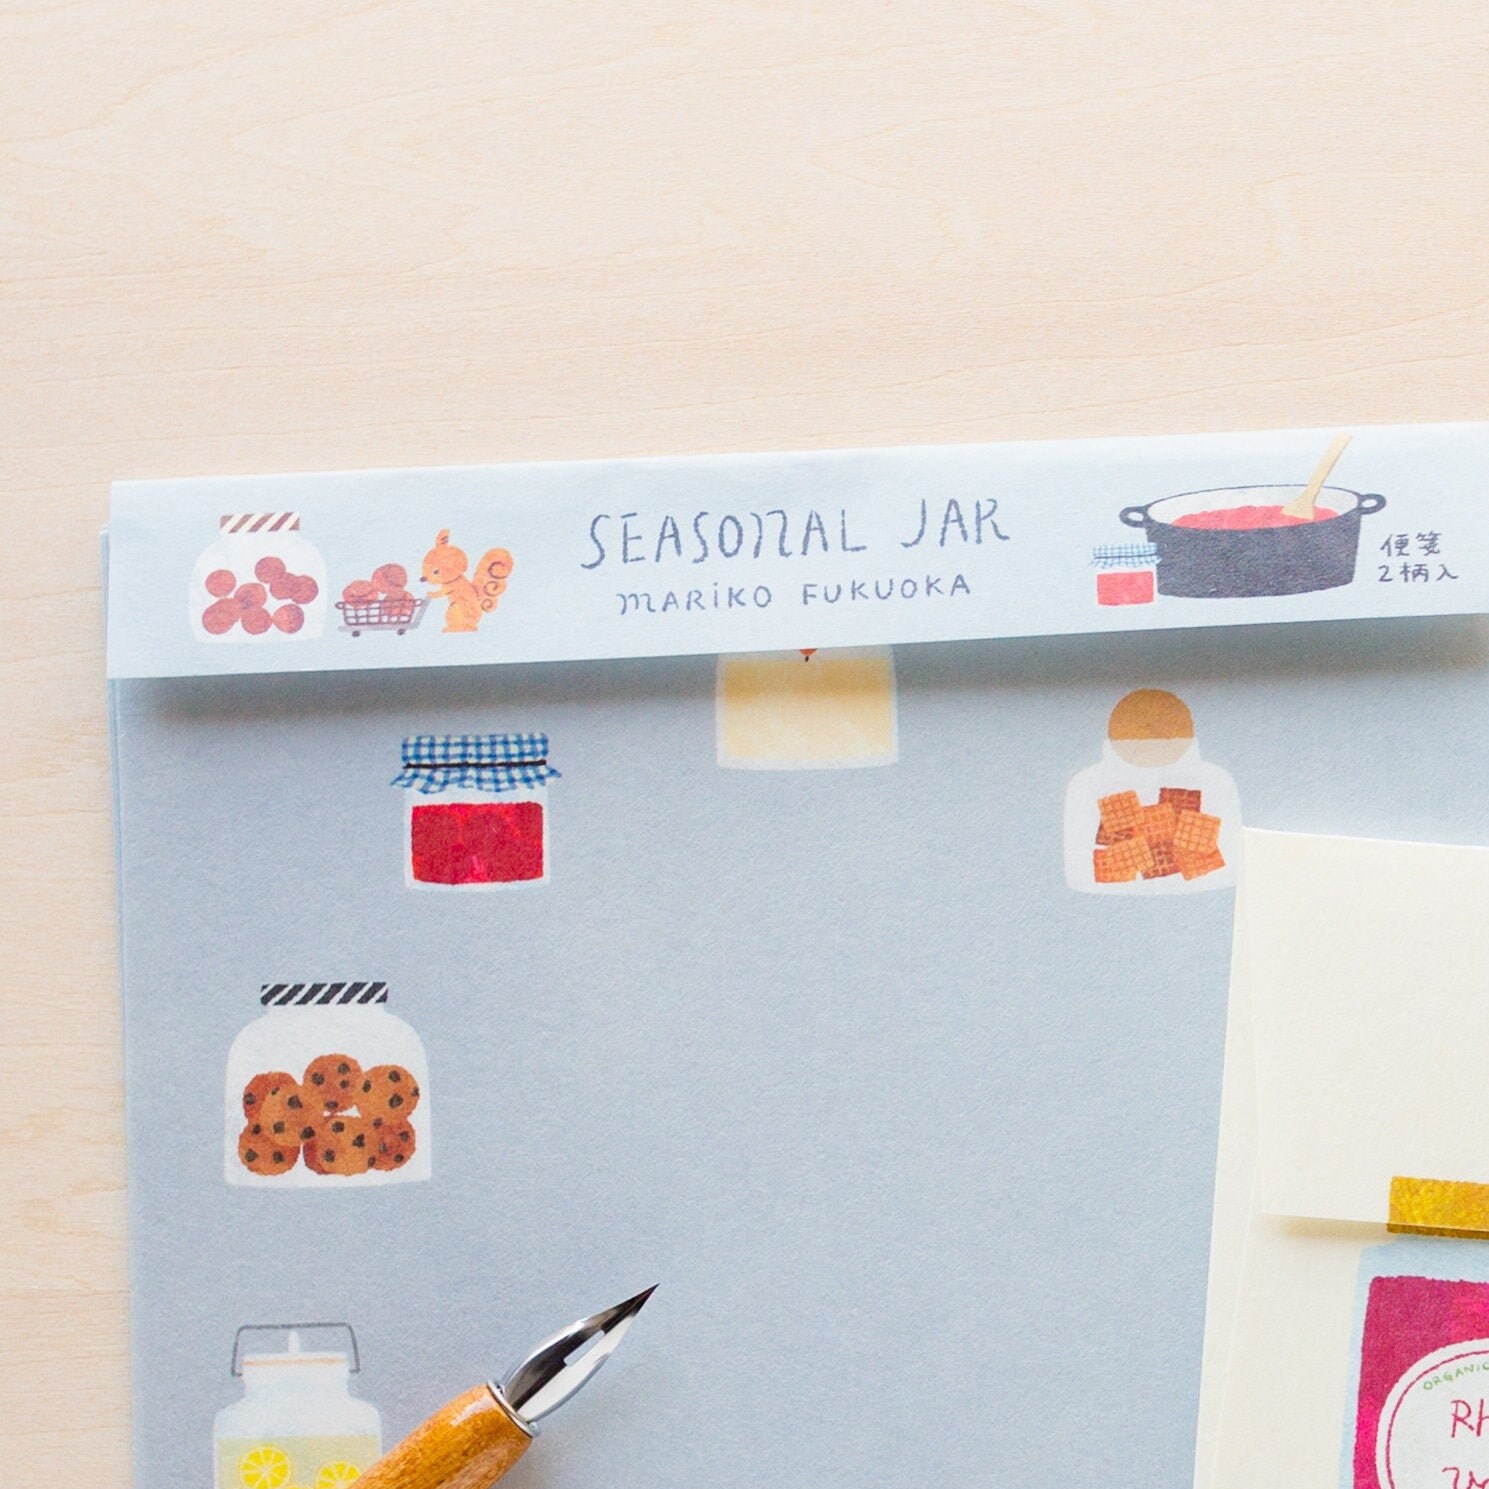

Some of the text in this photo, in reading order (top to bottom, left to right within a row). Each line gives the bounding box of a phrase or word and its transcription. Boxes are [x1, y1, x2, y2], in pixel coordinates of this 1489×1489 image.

[580, 498, 1011, 570] SEASONAL JAR
[802, 574, 971, 606] FUKUOKA
